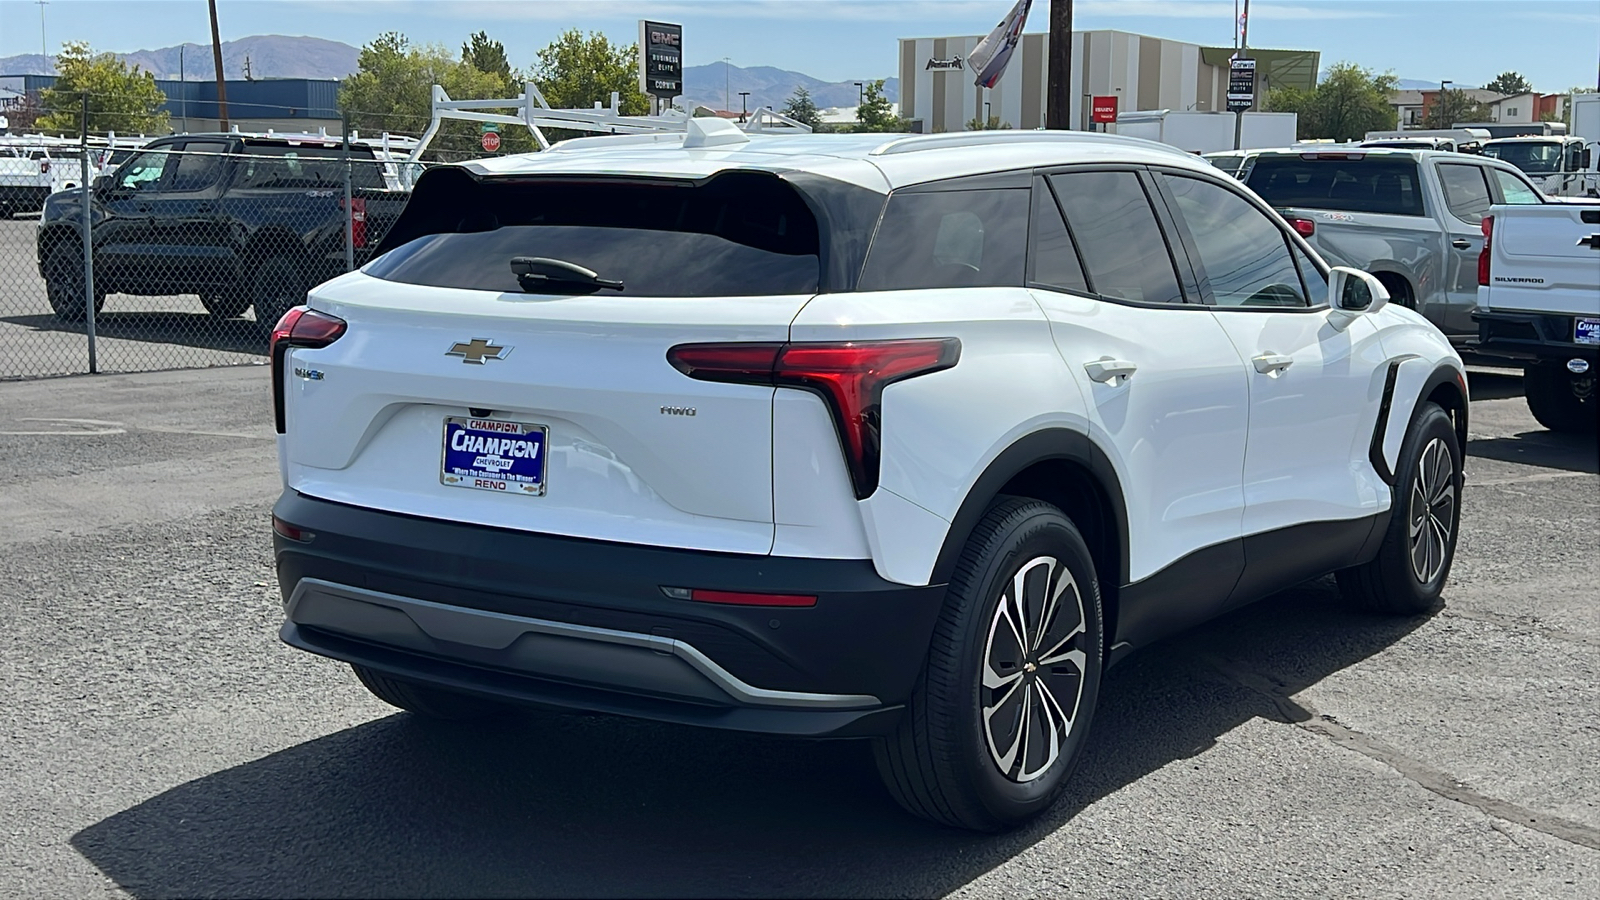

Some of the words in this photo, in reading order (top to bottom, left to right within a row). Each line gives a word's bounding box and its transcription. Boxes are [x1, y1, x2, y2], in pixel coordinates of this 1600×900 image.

[651, 31, 680, 46] GMC
[652, 53, 679, 63] BUSINESS
[658, 63, 674, 72] ELITE
[655, 80, 676, 90] CORWIN
[483, 138, 499, 146] STOP
[470, 420, 519, 433] CHAMPION
[451, 429, 540, 459] CHAMPION
[476, 458, 511, 468] CHEVROLET
[478, 470, 501, 479] Customer
[506, 473, 516, 481] The
[475, 480, 506, 490] RENO
